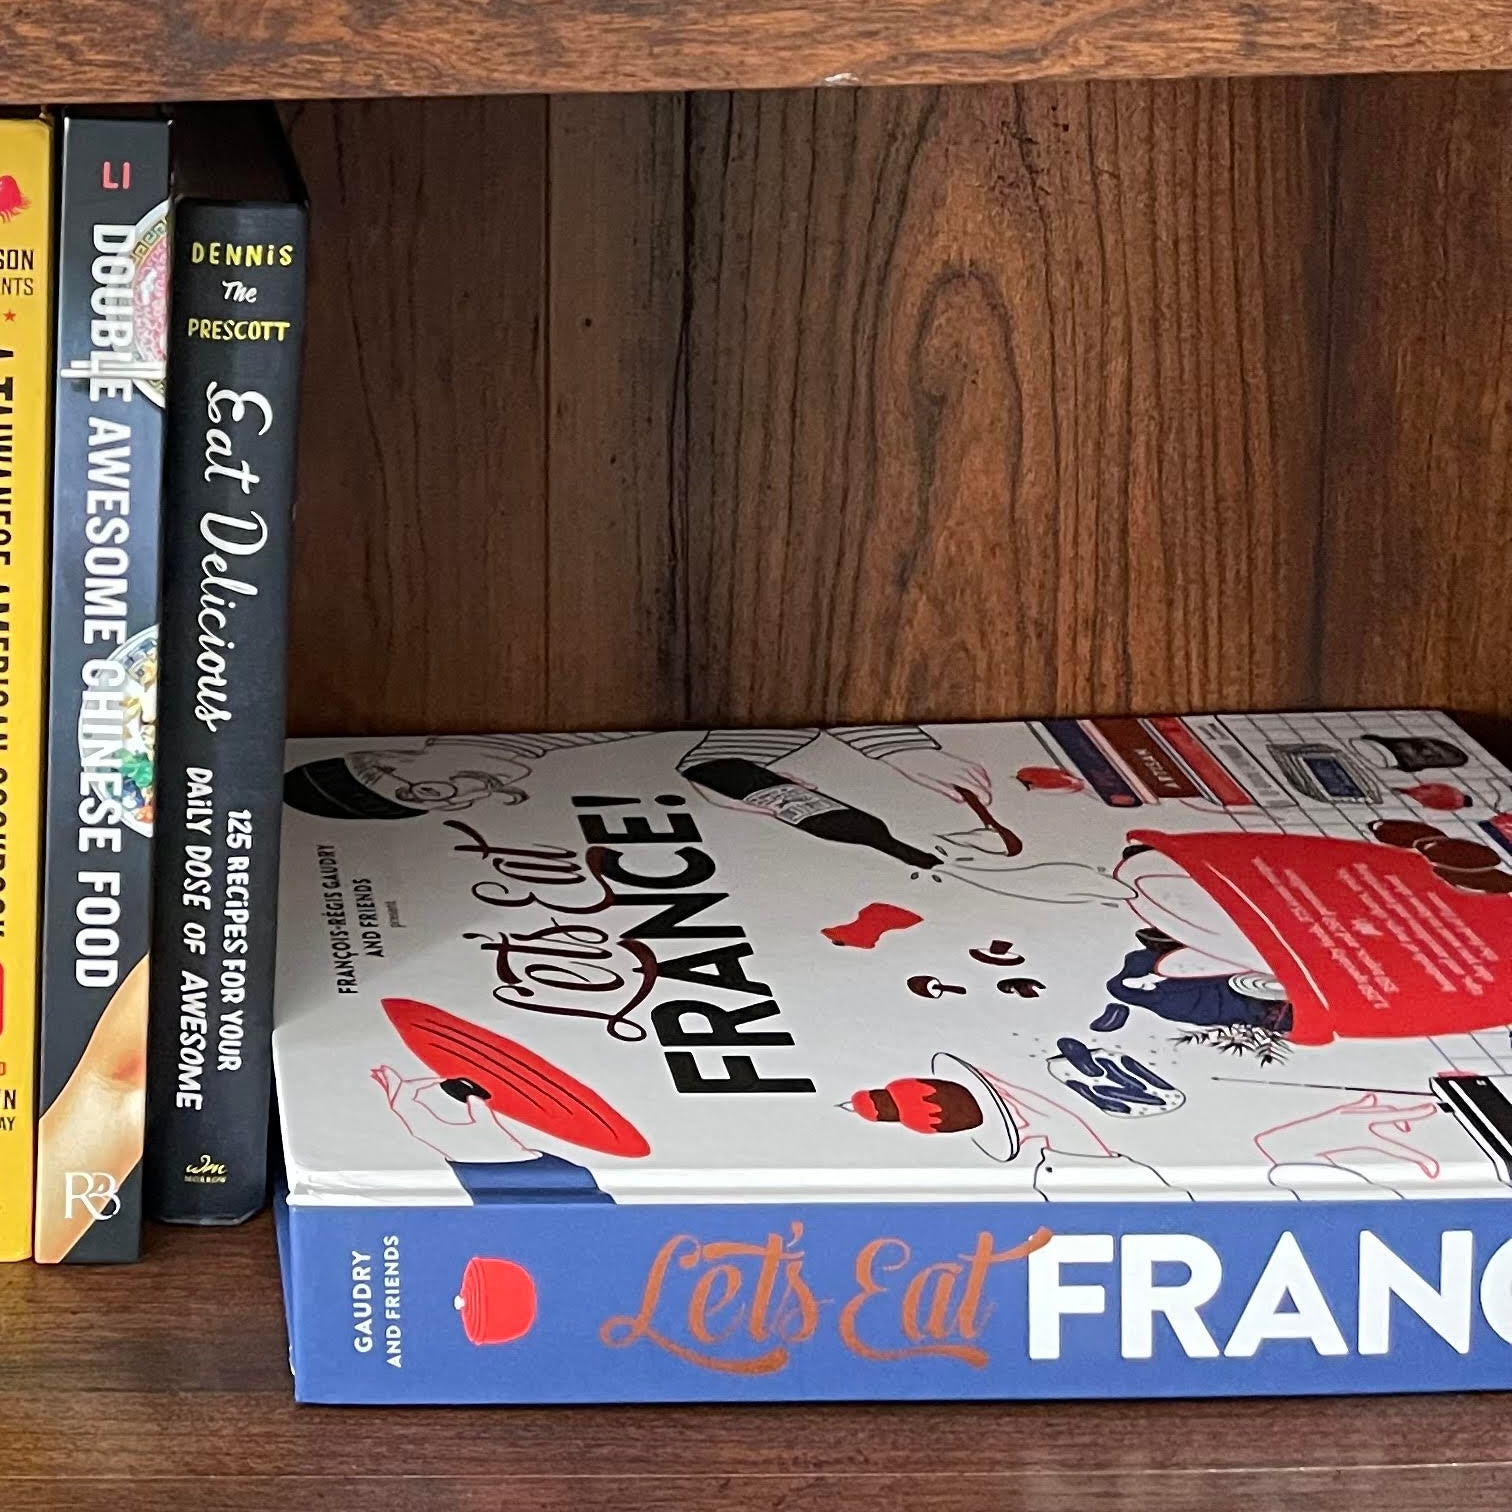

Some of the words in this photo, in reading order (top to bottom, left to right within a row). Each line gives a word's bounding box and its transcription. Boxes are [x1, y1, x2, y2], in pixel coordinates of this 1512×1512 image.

[90, 224, 136, 403] DOUBLE
[187, 317, 291, 343] PRESCOTT
[222, 281, 257, 304] The
[83, 415, 131, 645] AWESOME
[78, 659, 124, 853] CHINESE
[75, 870, 120, 988] FOOD
[570, 793, 816, 1094] FRANCE!
